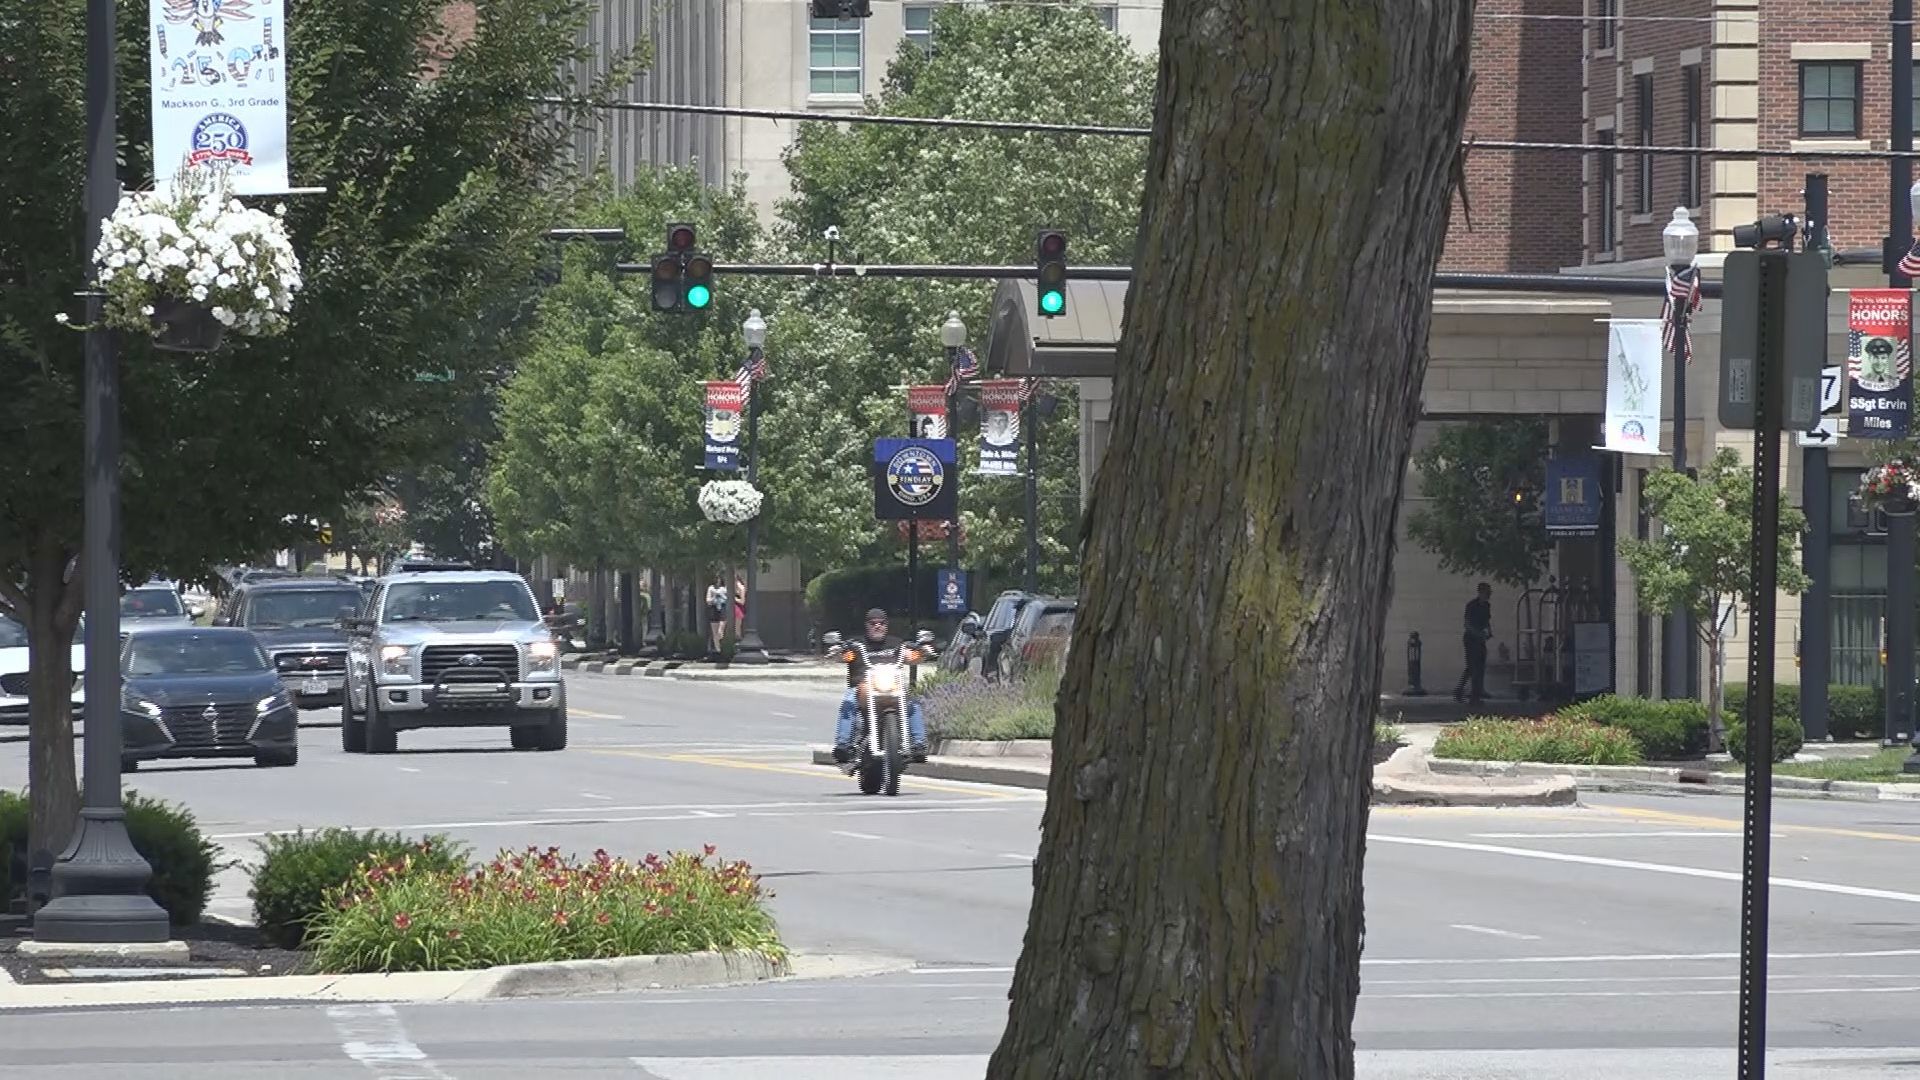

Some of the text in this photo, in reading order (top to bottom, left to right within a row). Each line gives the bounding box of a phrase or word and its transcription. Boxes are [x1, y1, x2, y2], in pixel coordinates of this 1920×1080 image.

[161, 97, 280, 109] Mackson G., 3rd Grade
[198, 115, 242, 132] AMERICA
[197, 132, 243, 153] 250
[1851, 309, 1909, 321] HONORS
[982, 393, 1018, 401] HONORS
[1850, 397, 1907, 411] SSgt Ervin
[1863, 416, 1892, 429] Miles
[893, 449, 938, 469] DOWNTOWN
